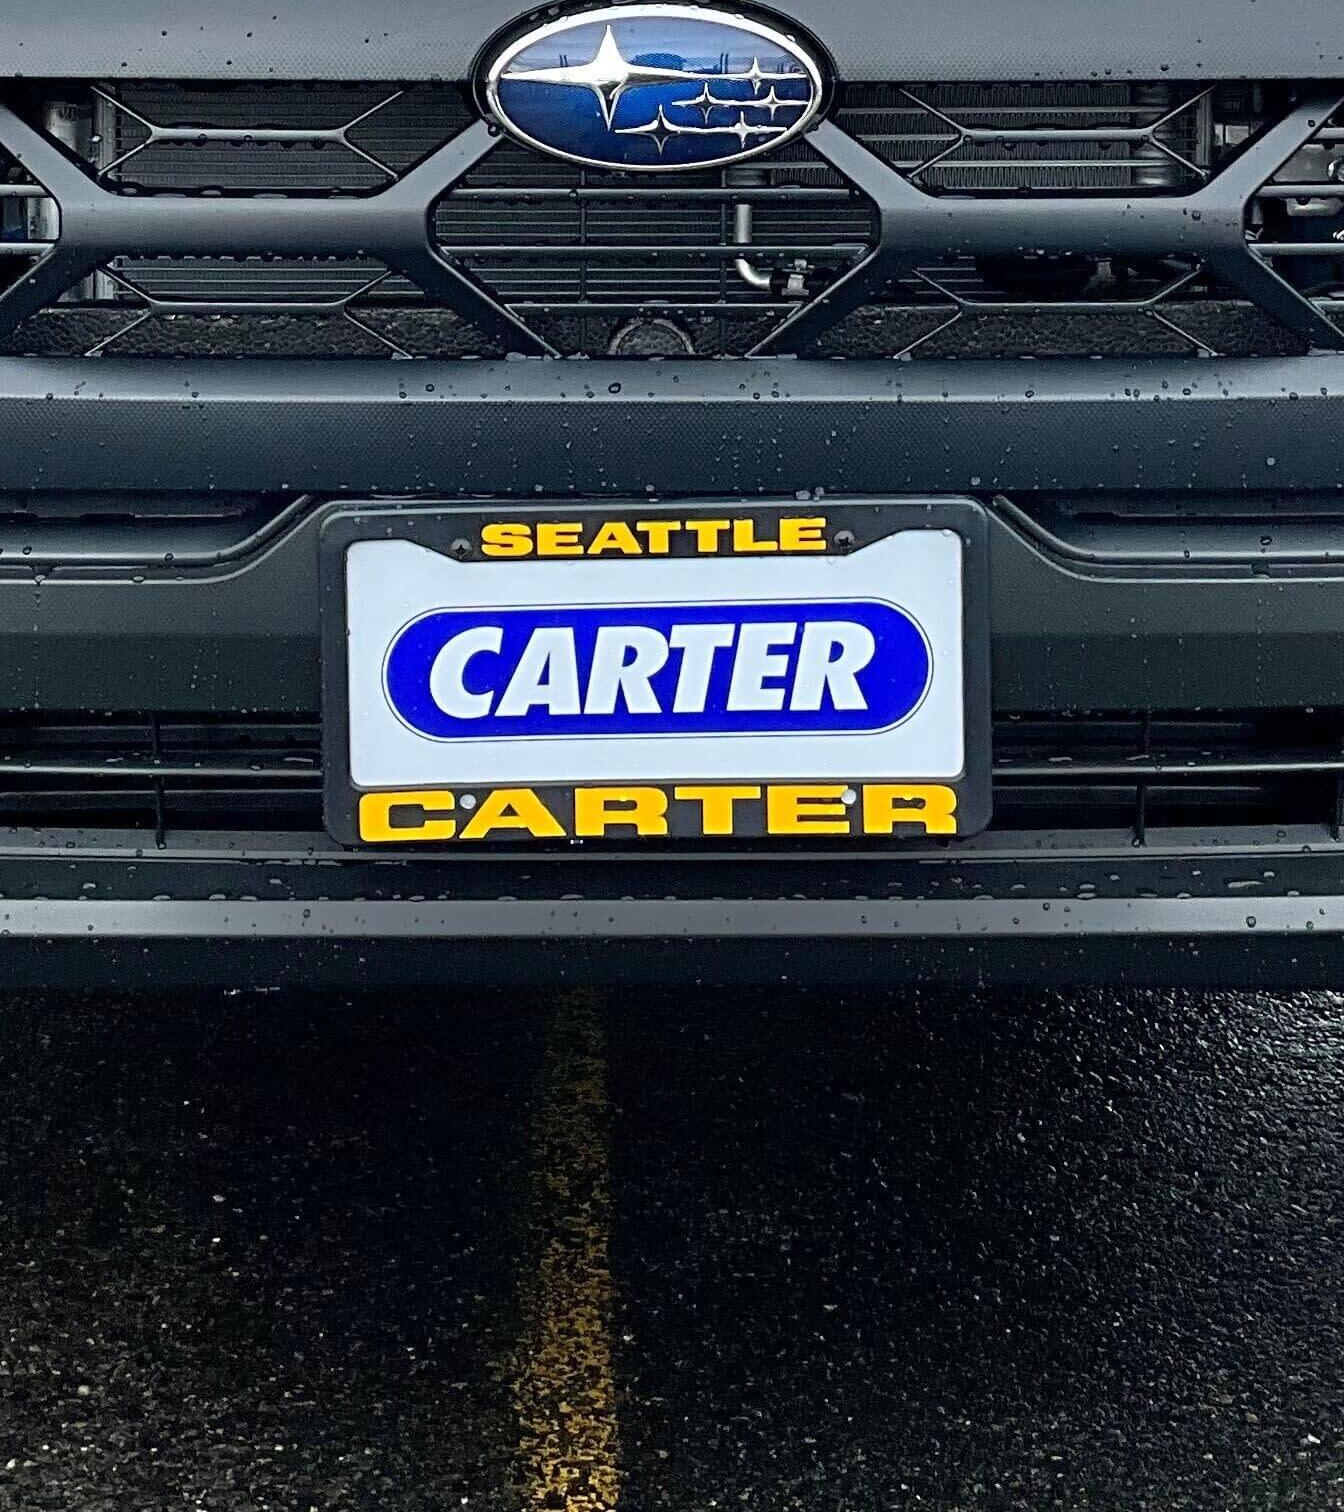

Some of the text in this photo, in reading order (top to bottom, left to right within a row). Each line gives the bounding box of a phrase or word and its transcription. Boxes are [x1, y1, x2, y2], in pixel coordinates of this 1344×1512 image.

[481, 517, 827, 557] SEATTLE
[429, 620, 876, 719] CARTER
[359, 784, 957, 842] CARTER
